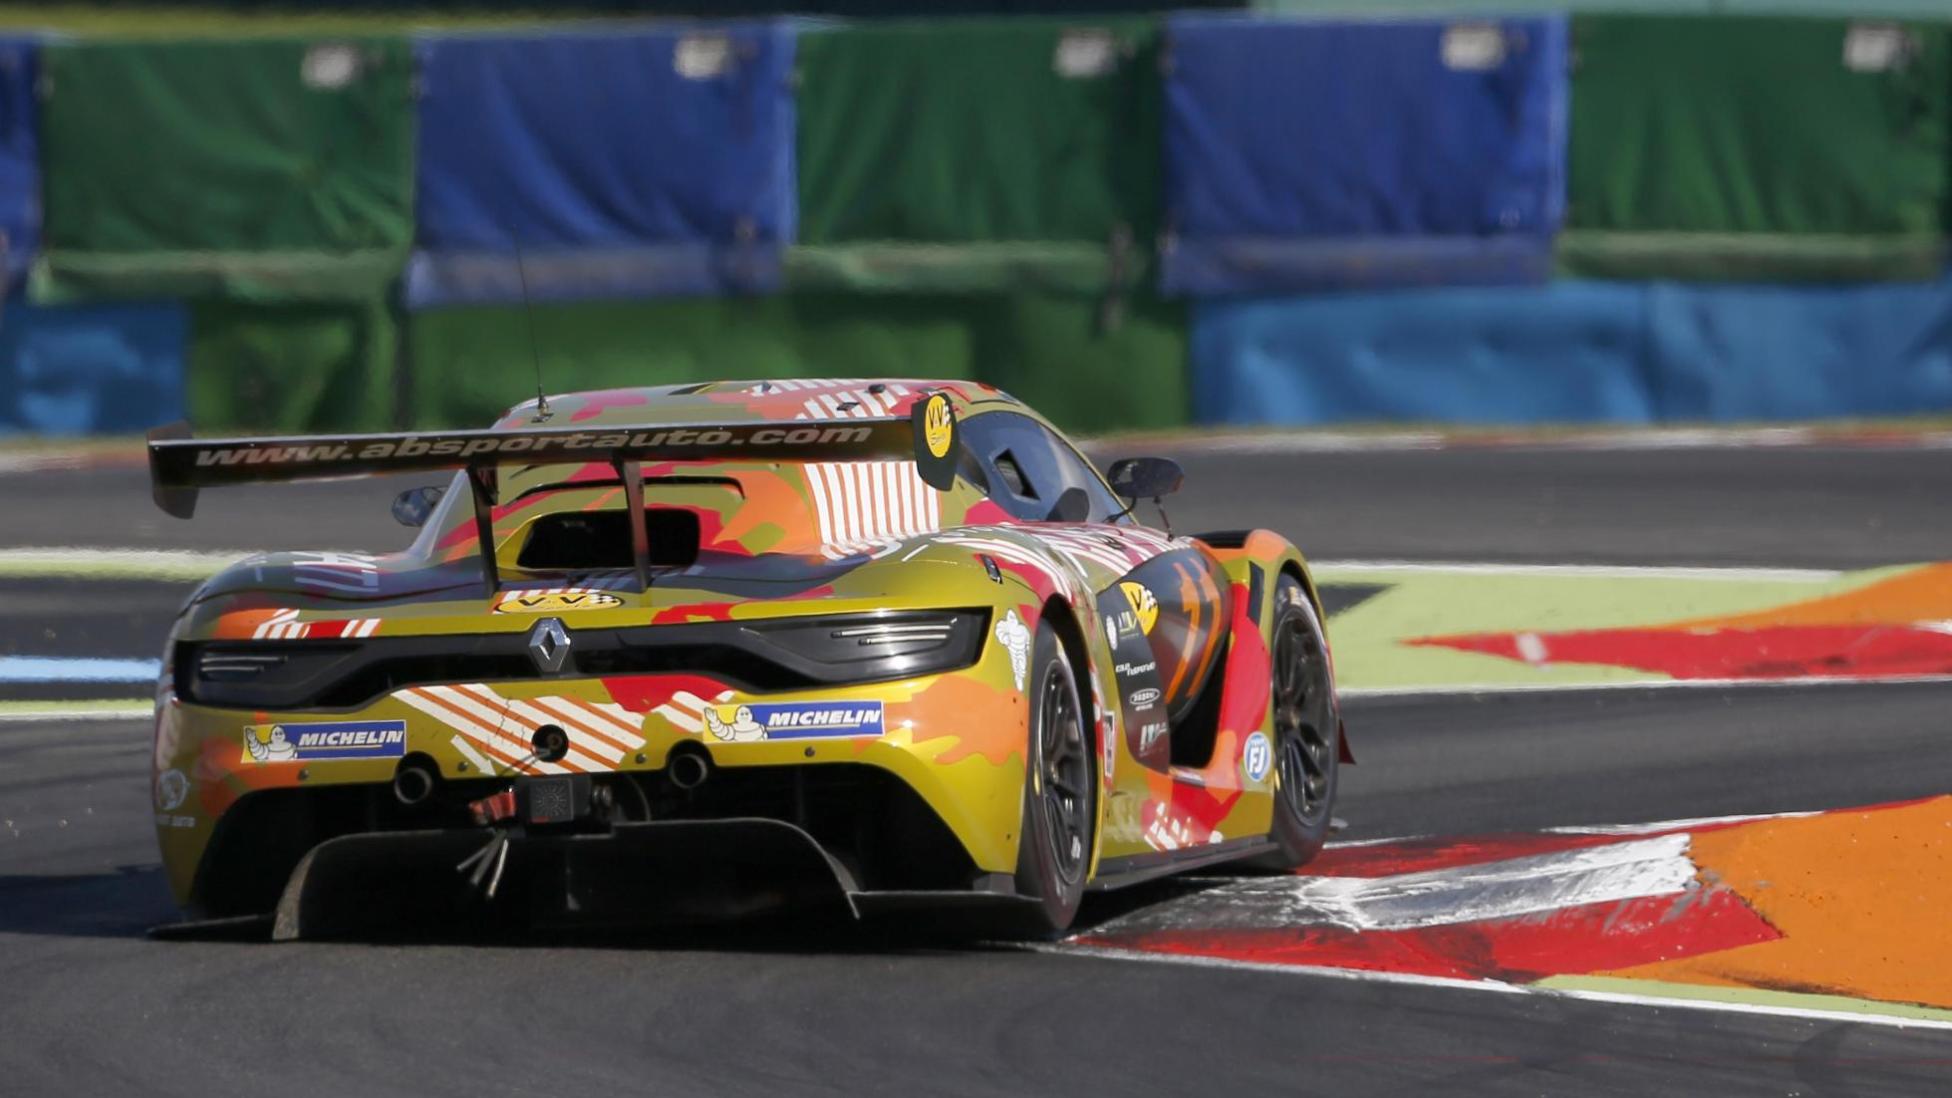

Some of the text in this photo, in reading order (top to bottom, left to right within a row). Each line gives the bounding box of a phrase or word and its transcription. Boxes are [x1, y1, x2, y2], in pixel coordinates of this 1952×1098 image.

[195, 426, 872, 467] www.absportauto.com
[767, 709, 881, 726] MICHELIN
[299, 730, 404, 746] MICHELIN
